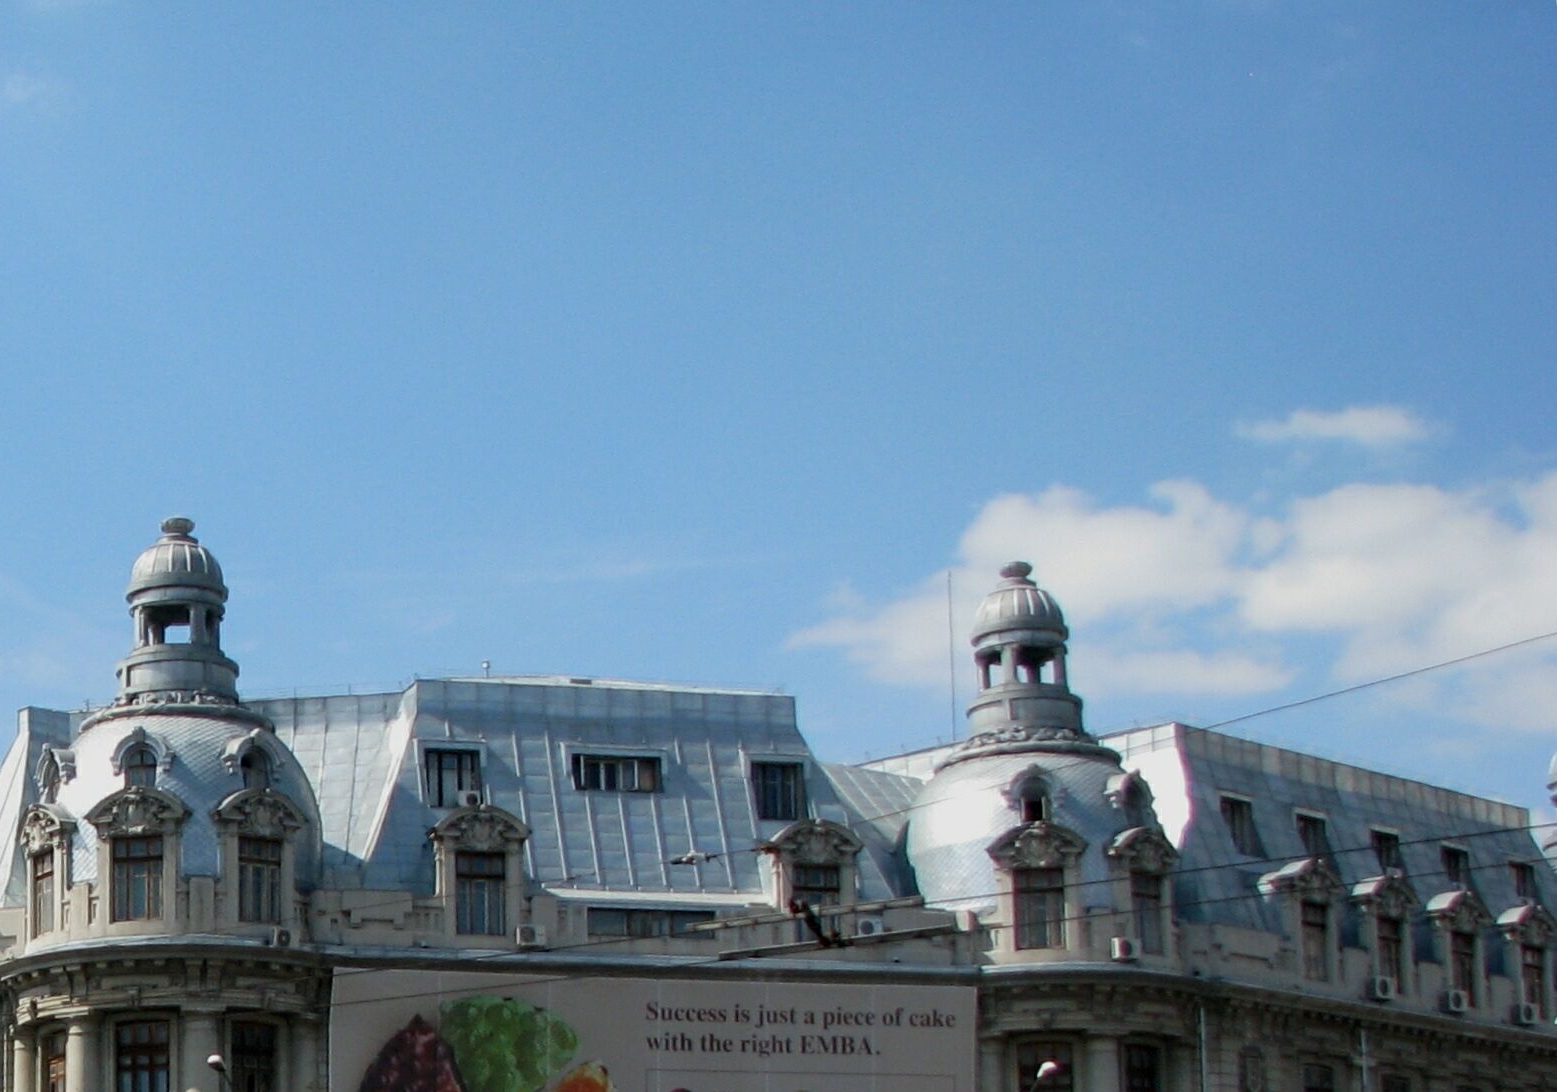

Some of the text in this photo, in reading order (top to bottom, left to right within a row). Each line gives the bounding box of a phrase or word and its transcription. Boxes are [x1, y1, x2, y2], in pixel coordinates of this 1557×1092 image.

[646, 1001, 956, 1029] Success is just a piece of cake
[646, 1033, 881, 1057] with the right EMBA.
